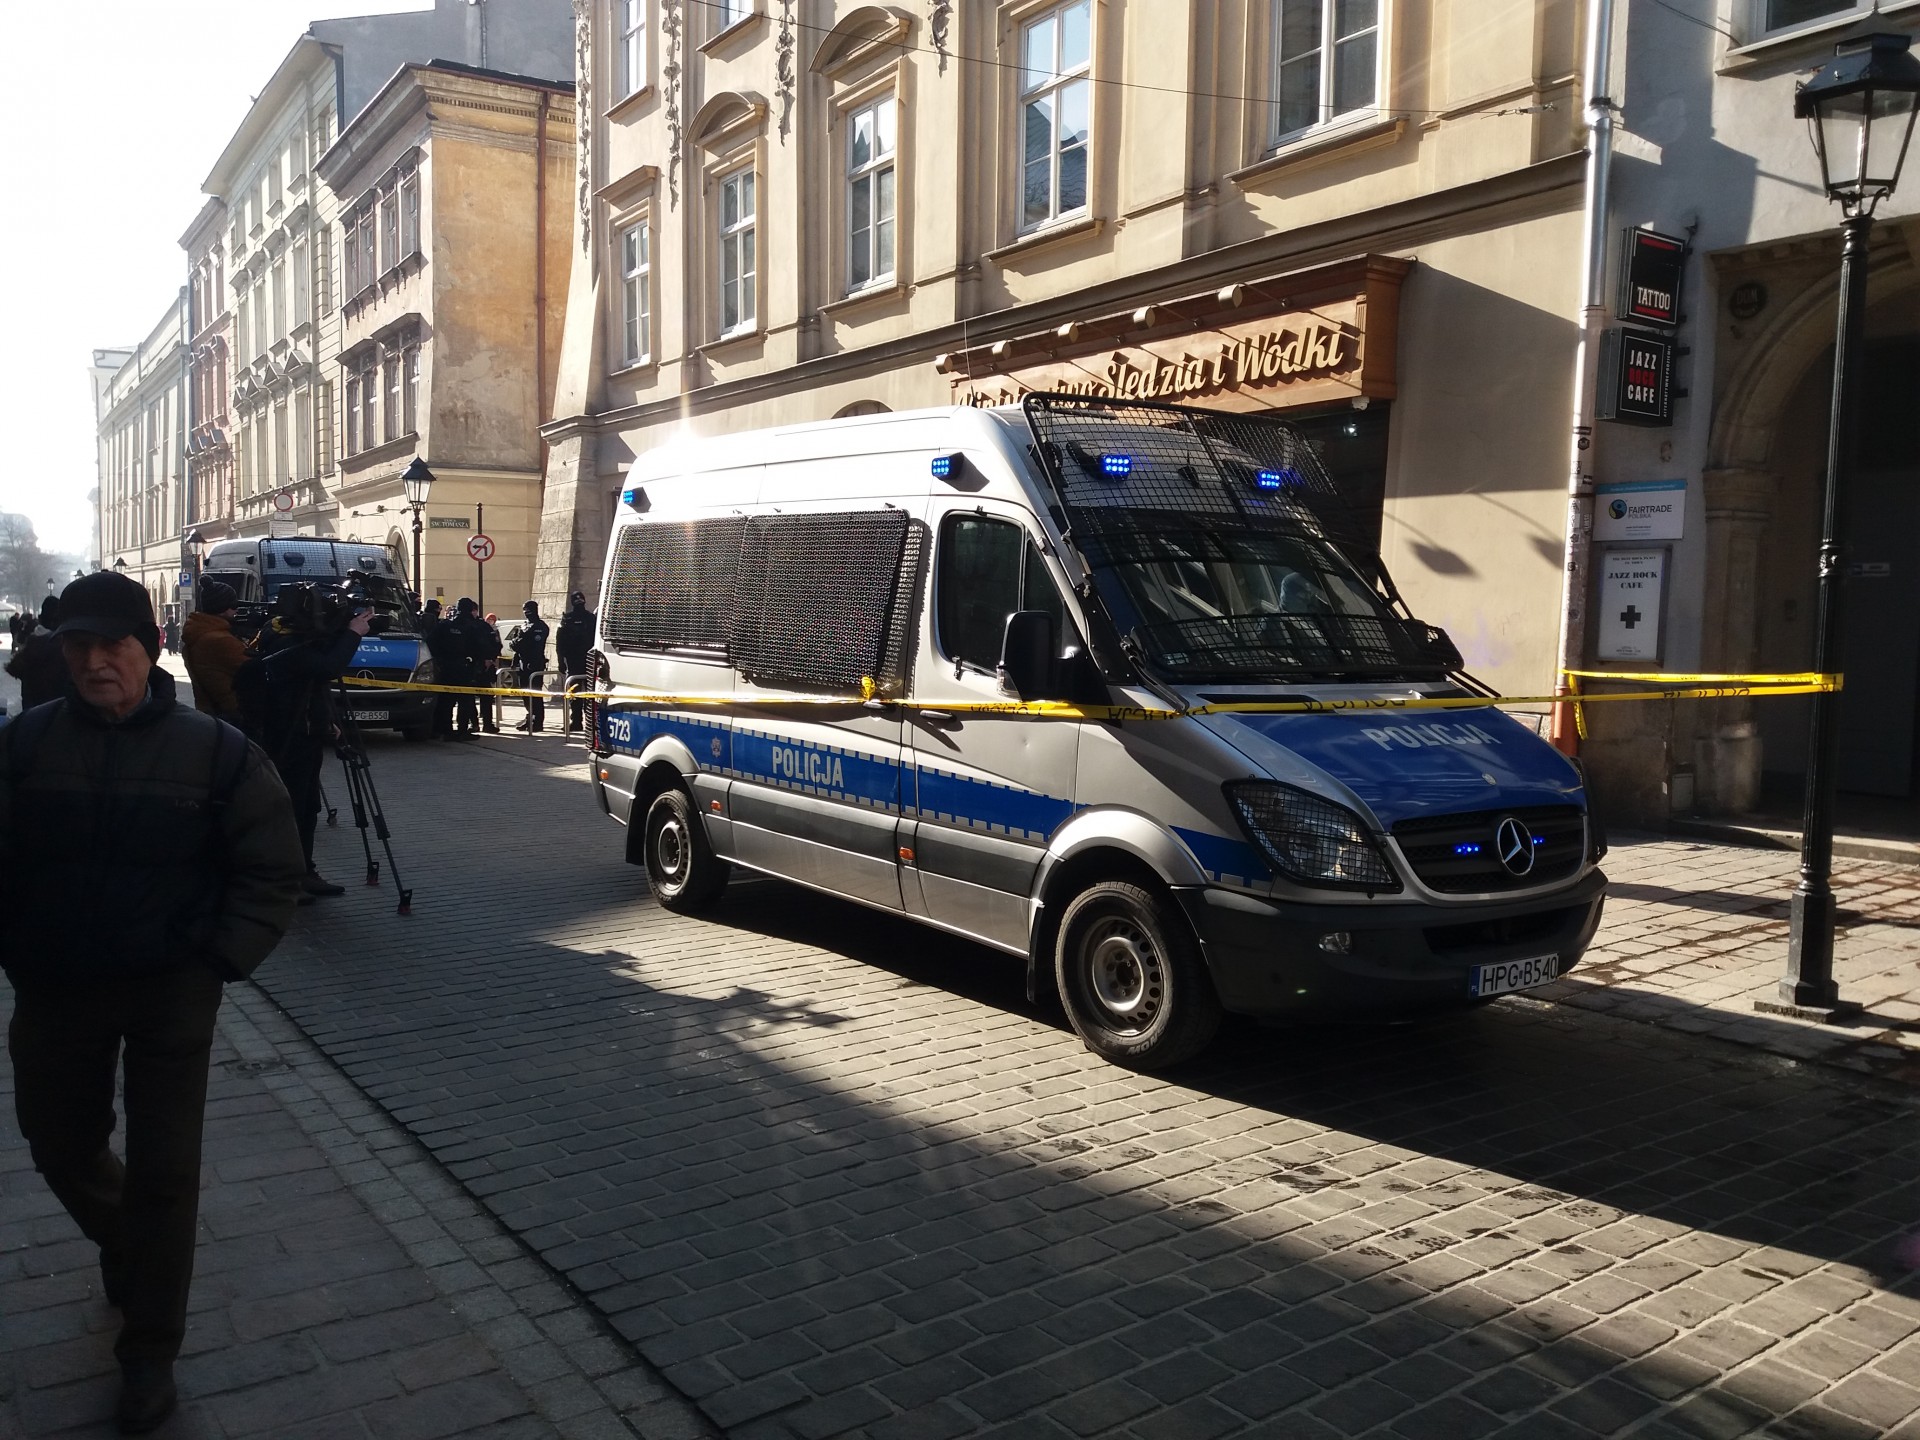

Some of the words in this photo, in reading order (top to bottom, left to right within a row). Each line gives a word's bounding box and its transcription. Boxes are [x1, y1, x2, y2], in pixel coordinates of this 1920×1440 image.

[1637, 286, 1671, 311] TATTOO
[1212, 343, 1226, 384] i
[1229, 325, 1344, 382] Wódki
[1629, 349, 1657, 370] JAZZ
[1628, 367, 1656, 388] ROCK
[1627, 385, 1655, 403] CAFE
[1628, 504, 1673, 514] FAIRTRADE
[181, 573, 190, 583] P
[1633, 571, 1658, 579] ROCK
[608, 716, 631, 743] G723
[1361, 723, 1502, 751] POLICJA
[772, 746, 844, 788] POLICJA
